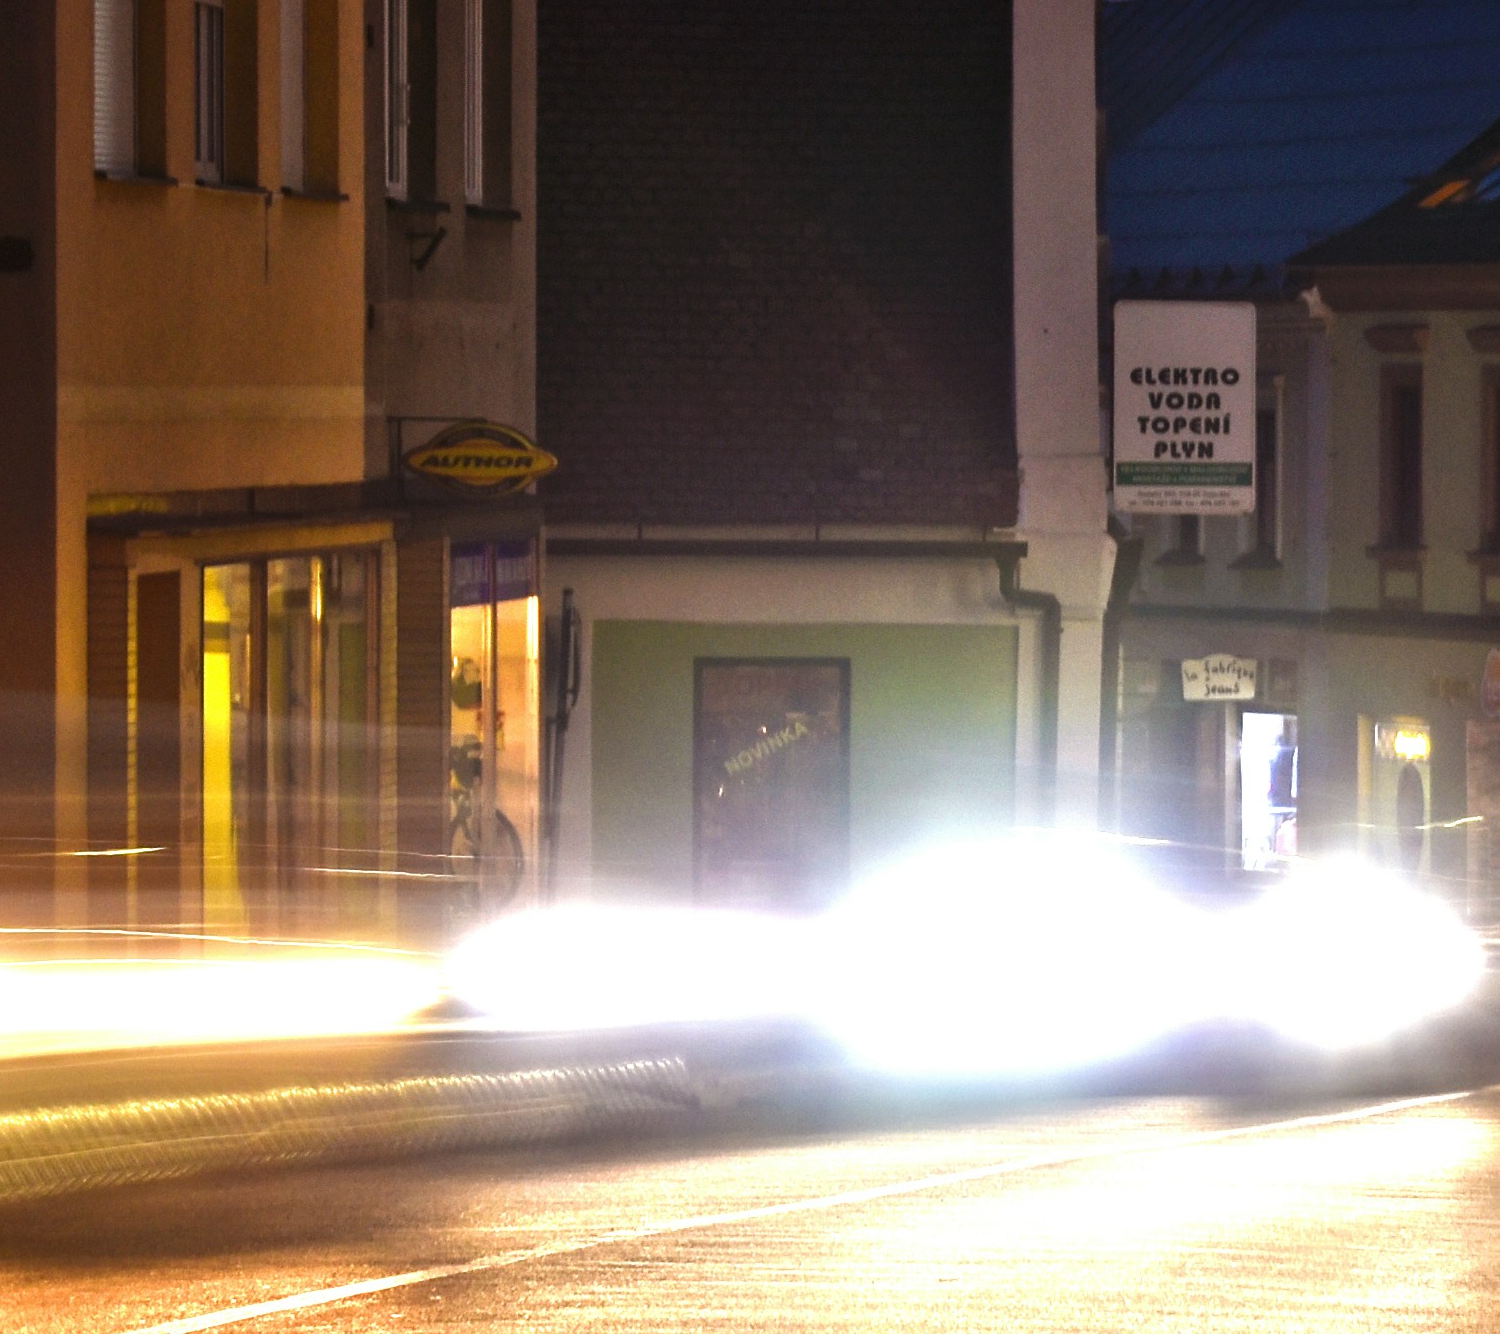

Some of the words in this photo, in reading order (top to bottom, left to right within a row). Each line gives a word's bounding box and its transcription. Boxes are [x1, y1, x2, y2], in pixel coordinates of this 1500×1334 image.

[1129, 367, 1240, 386] ELEKTRO
[1148, 392, 1221, 410] VODA
[1137, 414, 1231, 435] TOPENÍ
[1153, 441, 1214, 459] PLYN
[420, 455, 534, 468] AUTHOR
[725, 722, 809, 776] NOVINKA
